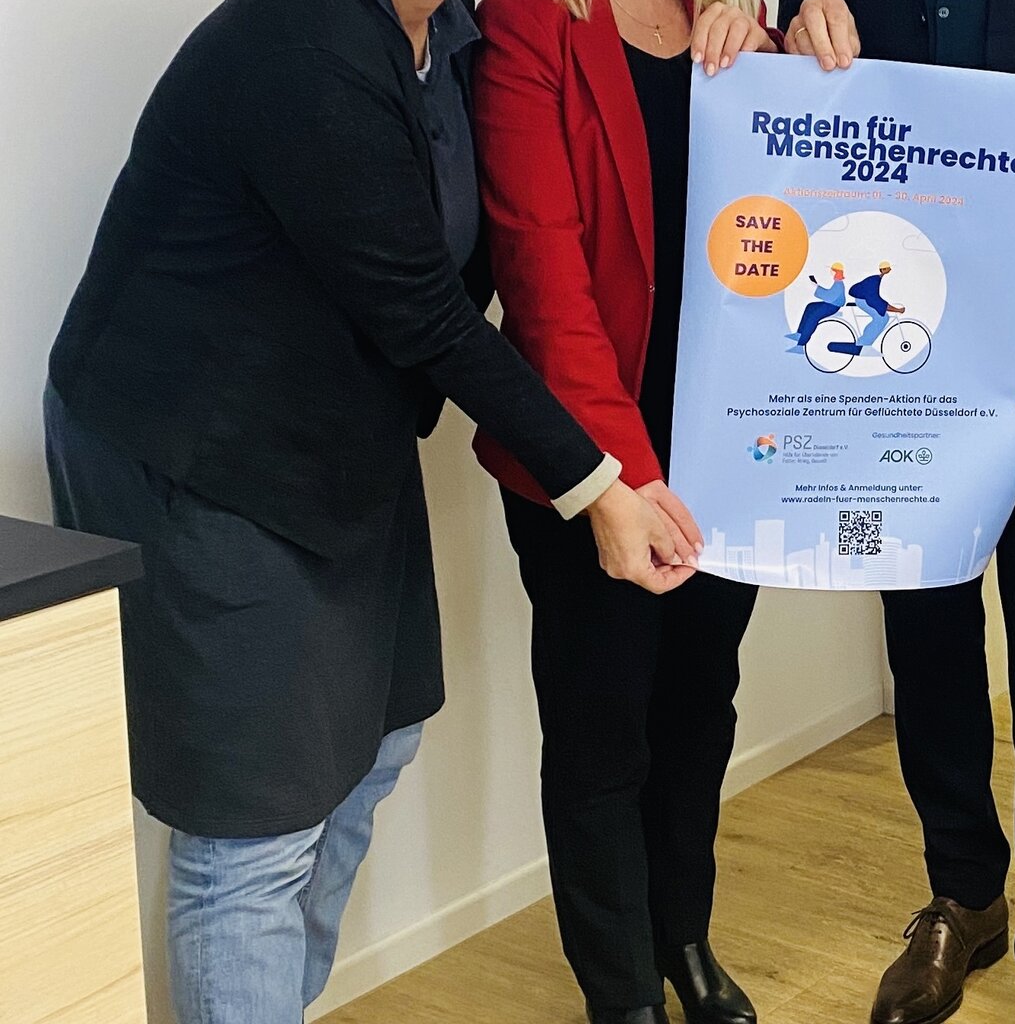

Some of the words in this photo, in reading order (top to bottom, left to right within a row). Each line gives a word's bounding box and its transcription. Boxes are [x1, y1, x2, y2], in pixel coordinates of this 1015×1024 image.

[752, 111, 860, 140] Radeln
[866, 115, 912, 142] für
[841, 160, 909, 184] 2024
[736, 215, 781, 230] SAVE
[741, 240, 774, 253] THE
[735, 263, 780, 277] DATE
[769, 394, 795, 403] Mehr
[797, 394, 813, 403] als
[815, 394, 837, 403] eine
[839, 394, 920, 406] Spenden-Aktion
[923, 394, 937, 404] für
[939, 395, 958, 404] das
[727, 407, 800, 419] Psychosoziale
[803, 407, 846, 416] Zentrum
[849, 407, 863, 416] für
[864, 407, 923, 417] Geflüchtete
[925, 407, 978, 417] Düsseldorf
[980, 409, 998, 417] e.V.
[783, 435, 813, 450] PSZ
[879, 449, 914, 463] AOK
[795, 484, 817, 492] Mehr
[818, 484, 839, 492] Infos
[840, 484, 847, 492] &
[849, 484, 897, 494] Anmeldung
[898, 484, 924, 493] unter:
[781, 495, 941, 504] www.radeln-fuer-menschenrechte.de
